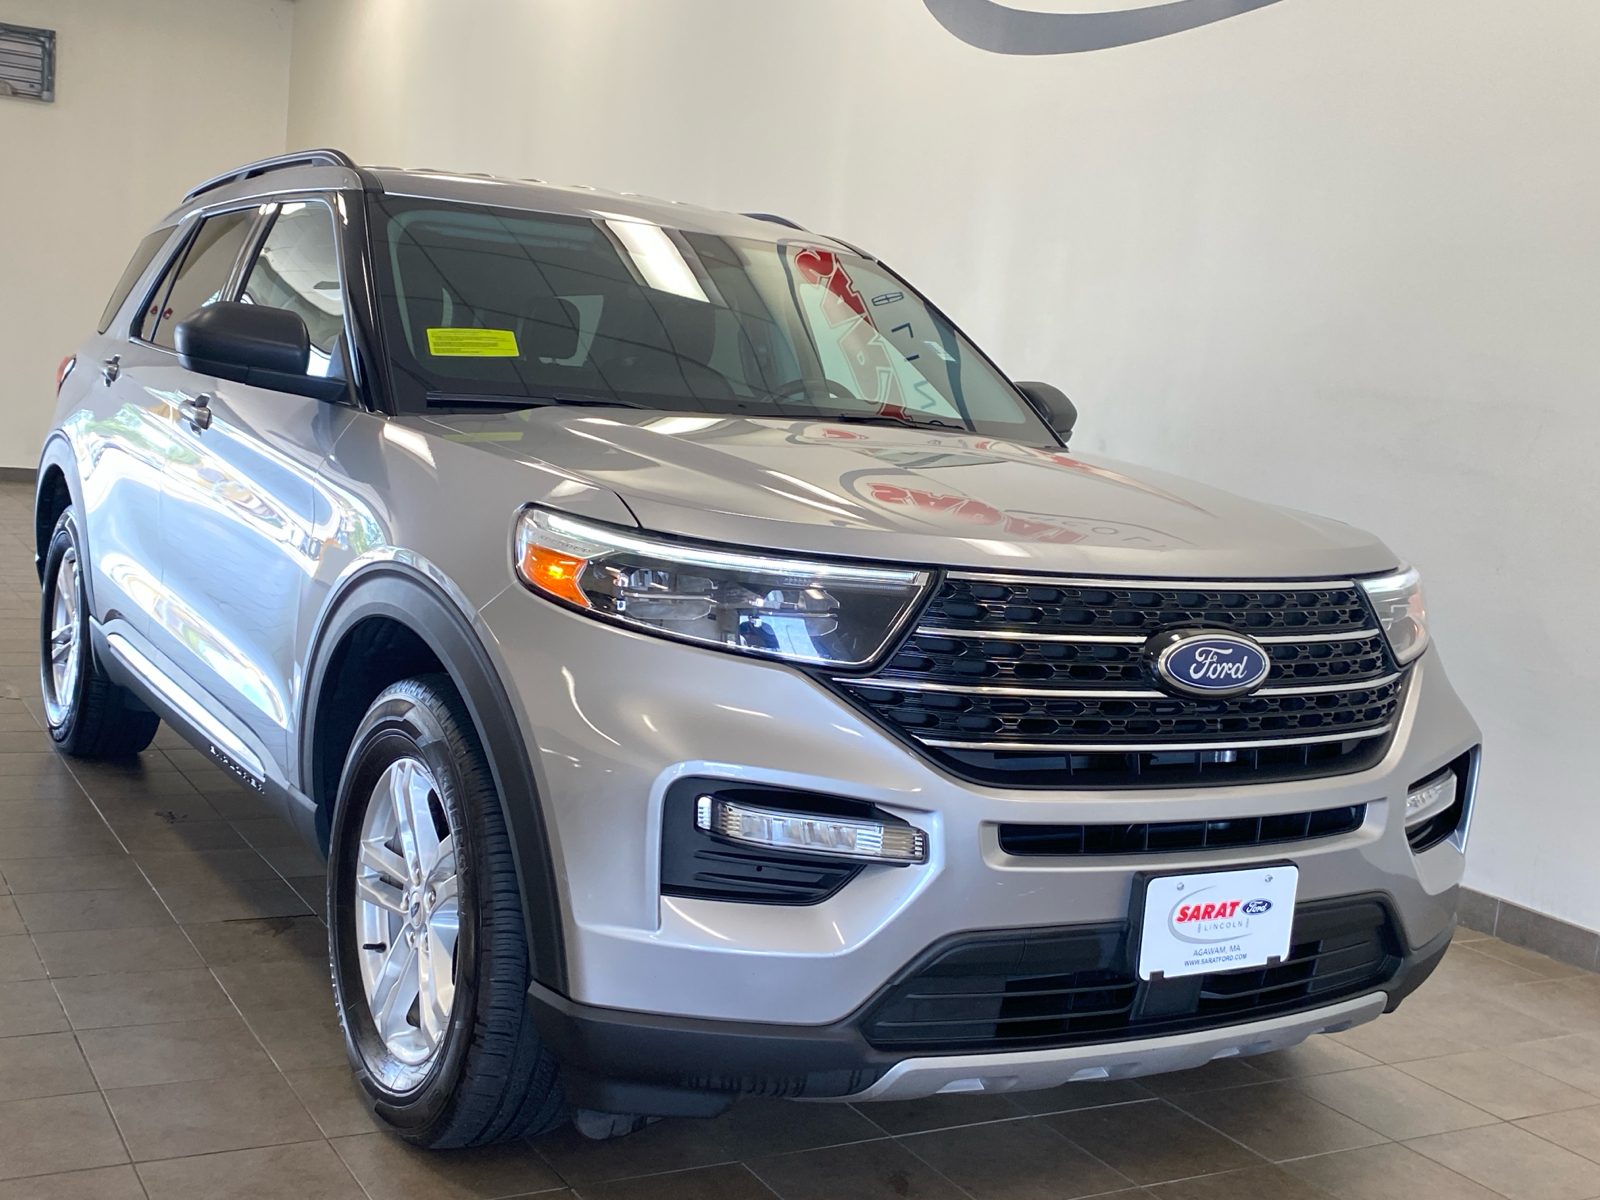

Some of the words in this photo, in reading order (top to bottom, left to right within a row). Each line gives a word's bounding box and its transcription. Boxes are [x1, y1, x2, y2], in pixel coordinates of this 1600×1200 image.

[1190, 647, 1248, 679] Ford
[1176, 900, 1242, 923] SARAT
[1245, 901, 1269, 914] Ford
[1204, 921, 1243, 931] LINCOLN
[1193, 946, 1228, 957] AGAWAM,
[1229, 944, 1241, 953] MA
[1184, 953, 1248, 967] WWW.SARATFORD.COM
